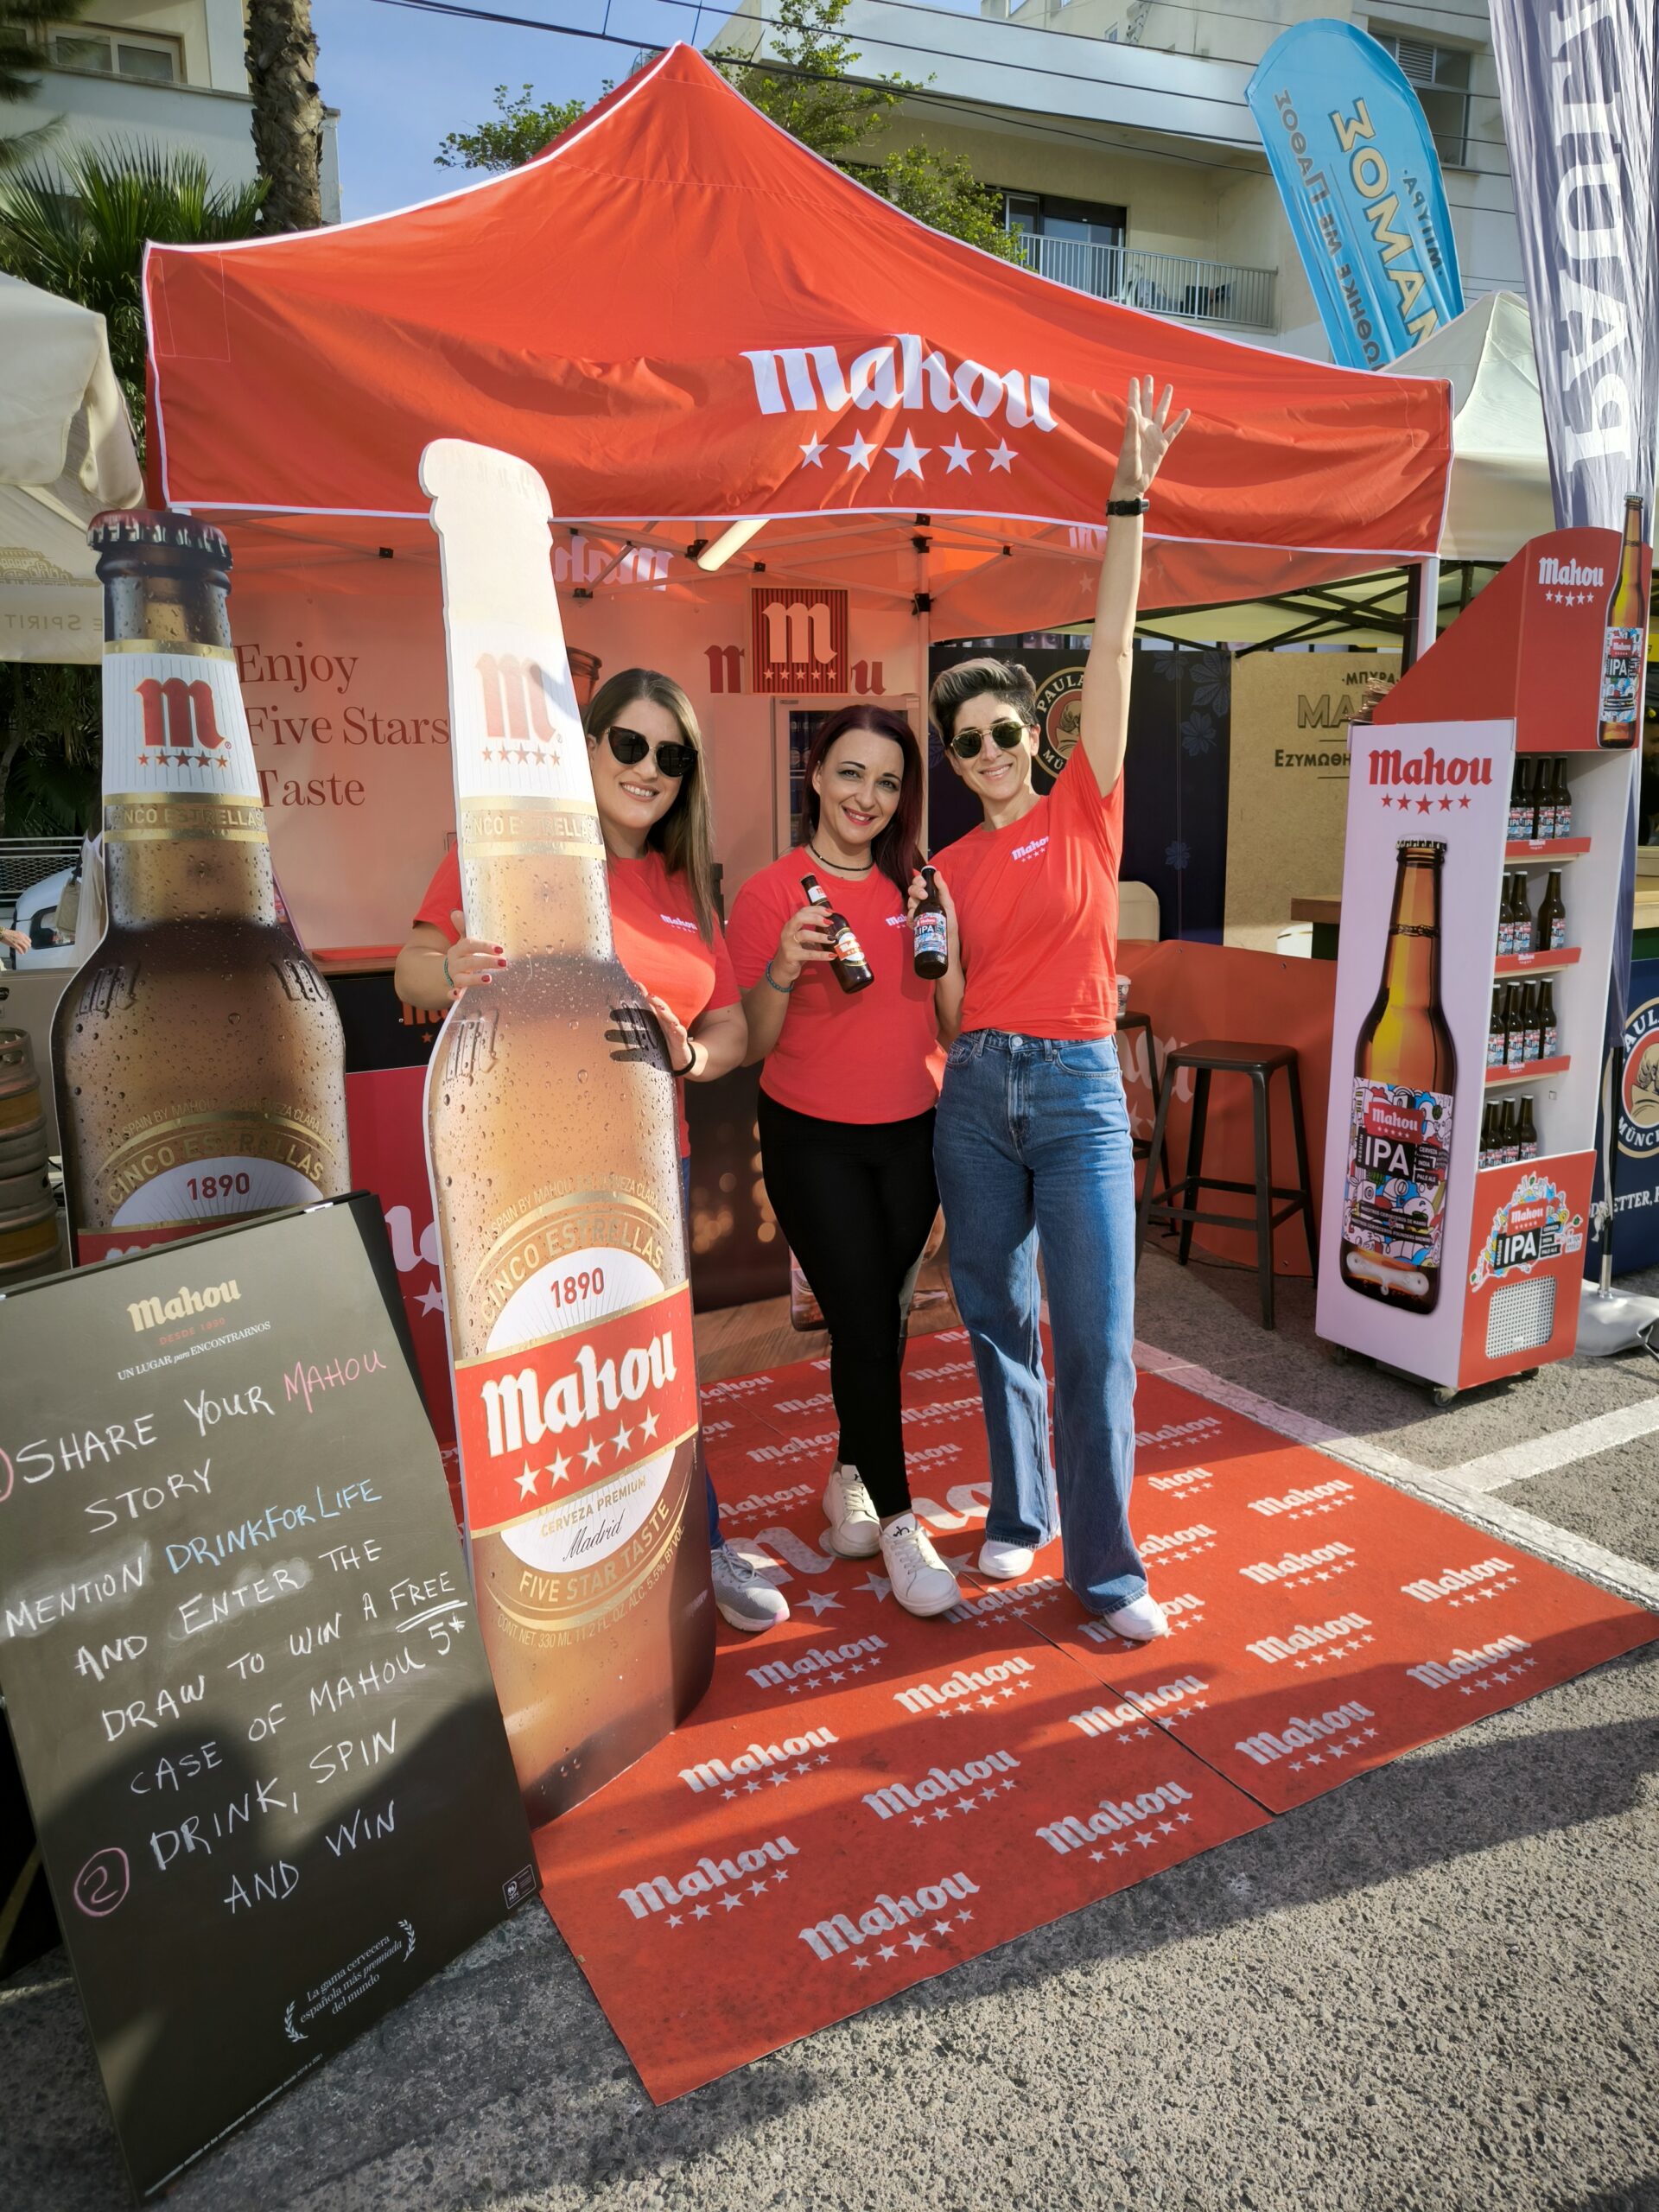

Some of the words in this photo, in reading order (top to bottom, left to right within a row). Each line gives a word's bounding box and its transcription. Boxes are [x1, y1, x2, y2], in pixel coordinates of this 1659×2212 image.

[1538, 556, 1605, 588] Mahou
[237, 645, 359, 693] Enjoy
[1609, 658, 1627, 676] IPA
[247, 708, 333, 746] Five
[342, 707, 448, 745] Stars
[257, 770, 366, 807] Taste
[1369, 747, 1493, 787] Mahou
[918, 925, 935, 934] IPA
[1372, 1108, 1418, 1131] Mahou
[107, 1147, 176, 1205] CINCO
[1364, 1136, 1409, 1176] IPA
[187, 1173, 250, 1200] 1890
[1614, 1191, 1652, 1213] ETTER,
[1511, 1208, 1543, 1224] Mahou
[480, 1243, 539, 1325] CINCO
[545, 1217, 664, 1269] ESTRELLAS
[1504, 1232, 1536, 1264] IPA
[127, 1280, 242, 1332] Mahou
[551, 1268, 605, 1308] 1890
[117, 1367, 135, 1382] UN
[135, 1355, 173, 1376] LUGAR
[173, 1350, 190, 1364] para
[190, 1321, 271, 1357] ENCONTRARNOS
[159, 1326, 196, 1346] DESDE
[16, 1414, 157, 1483] SHARE
[184, 1386, 276, 1437] YOUR
[283, 1350, 387, 1414] MAHOU
[480, 1330, 677, 1459] Mahou
[85, 1459, 214, 1534] STORY
[540, 1504, 594, 1538] CERVEZA
[597, 1476, 646, 1511] PREMIUM
[1248, 1478, 1354, 1517] Mahou
[519, 1570, 561, 1602] FIVE
[567, 1560, 617, 1601] STAR
[621, 1497, 670, 1569] TASTE
[563, 1508, 626, 1562] Madrid
[1239, 1541, 1356, 1586] Mahou
[5, 1541, 149, 1638] MENTION
[538, 1633, 556, 1649] 330
[560, 1632, 573, 1646] ML
[647, 1561, 667, 1589] 5.5%
[664, 1548, 677, 1565] BY
[1401, 1557, 1515, 1603] Mahou
[74, 1635, 149, 1683] AND
[179, 1567, 308, 1635] ENTER
[319, 1540, 383, 1573] THE
[1245, 1611, 1373, 1663] Mahou
[102, 1675, 206, 1741] DRAW
[227, 1651, 266, 1680] TO
[289, 1613, 341, 1656] WIN
[363, 1592, 378, 1622] A
[390, 1571, 456, 1612] FREE
[745, 1634, 888, 1689] Mahou
[893, 1656, 1036, 1713] Mahou
[1406, 1633, 1532, 1689] Mahou
[130, 1741, 222, 1794] CASE
[248, 1703, 287, 1742] OF
[310, 1647, 426, 1715] MAHOU
[1067, 1675, 1209, 1738] Mahou
[1234, 1700, 1375, 1765] Mahou
[309, 1719, 397, 1783] SPIN
[677, 1726, 840, 1793] Mahou
[861, 1750, 1021, 1820] Mahou
[1036, 1781, 1192, 1855] Mahou
[223, 1860, 299, 1914] AND
[325, 1800, 396, 1856] WIN
[617, 1835, 800, 1920] Mahou
[798, 1872, 980, 1961] Mahou
[300, 1987, 342, 2023] española
[343, 1972, 363, 1991] más
[363, 1940, 403, 1978] premiada
[307, 1990, 320, 2002] La
[321, 1969, 346, 1995] gama
[346, 1936, 391, 1972] cervecera
[332, 1996, 346, 2015] del
[347, 1974, 380, 2002] mundo
